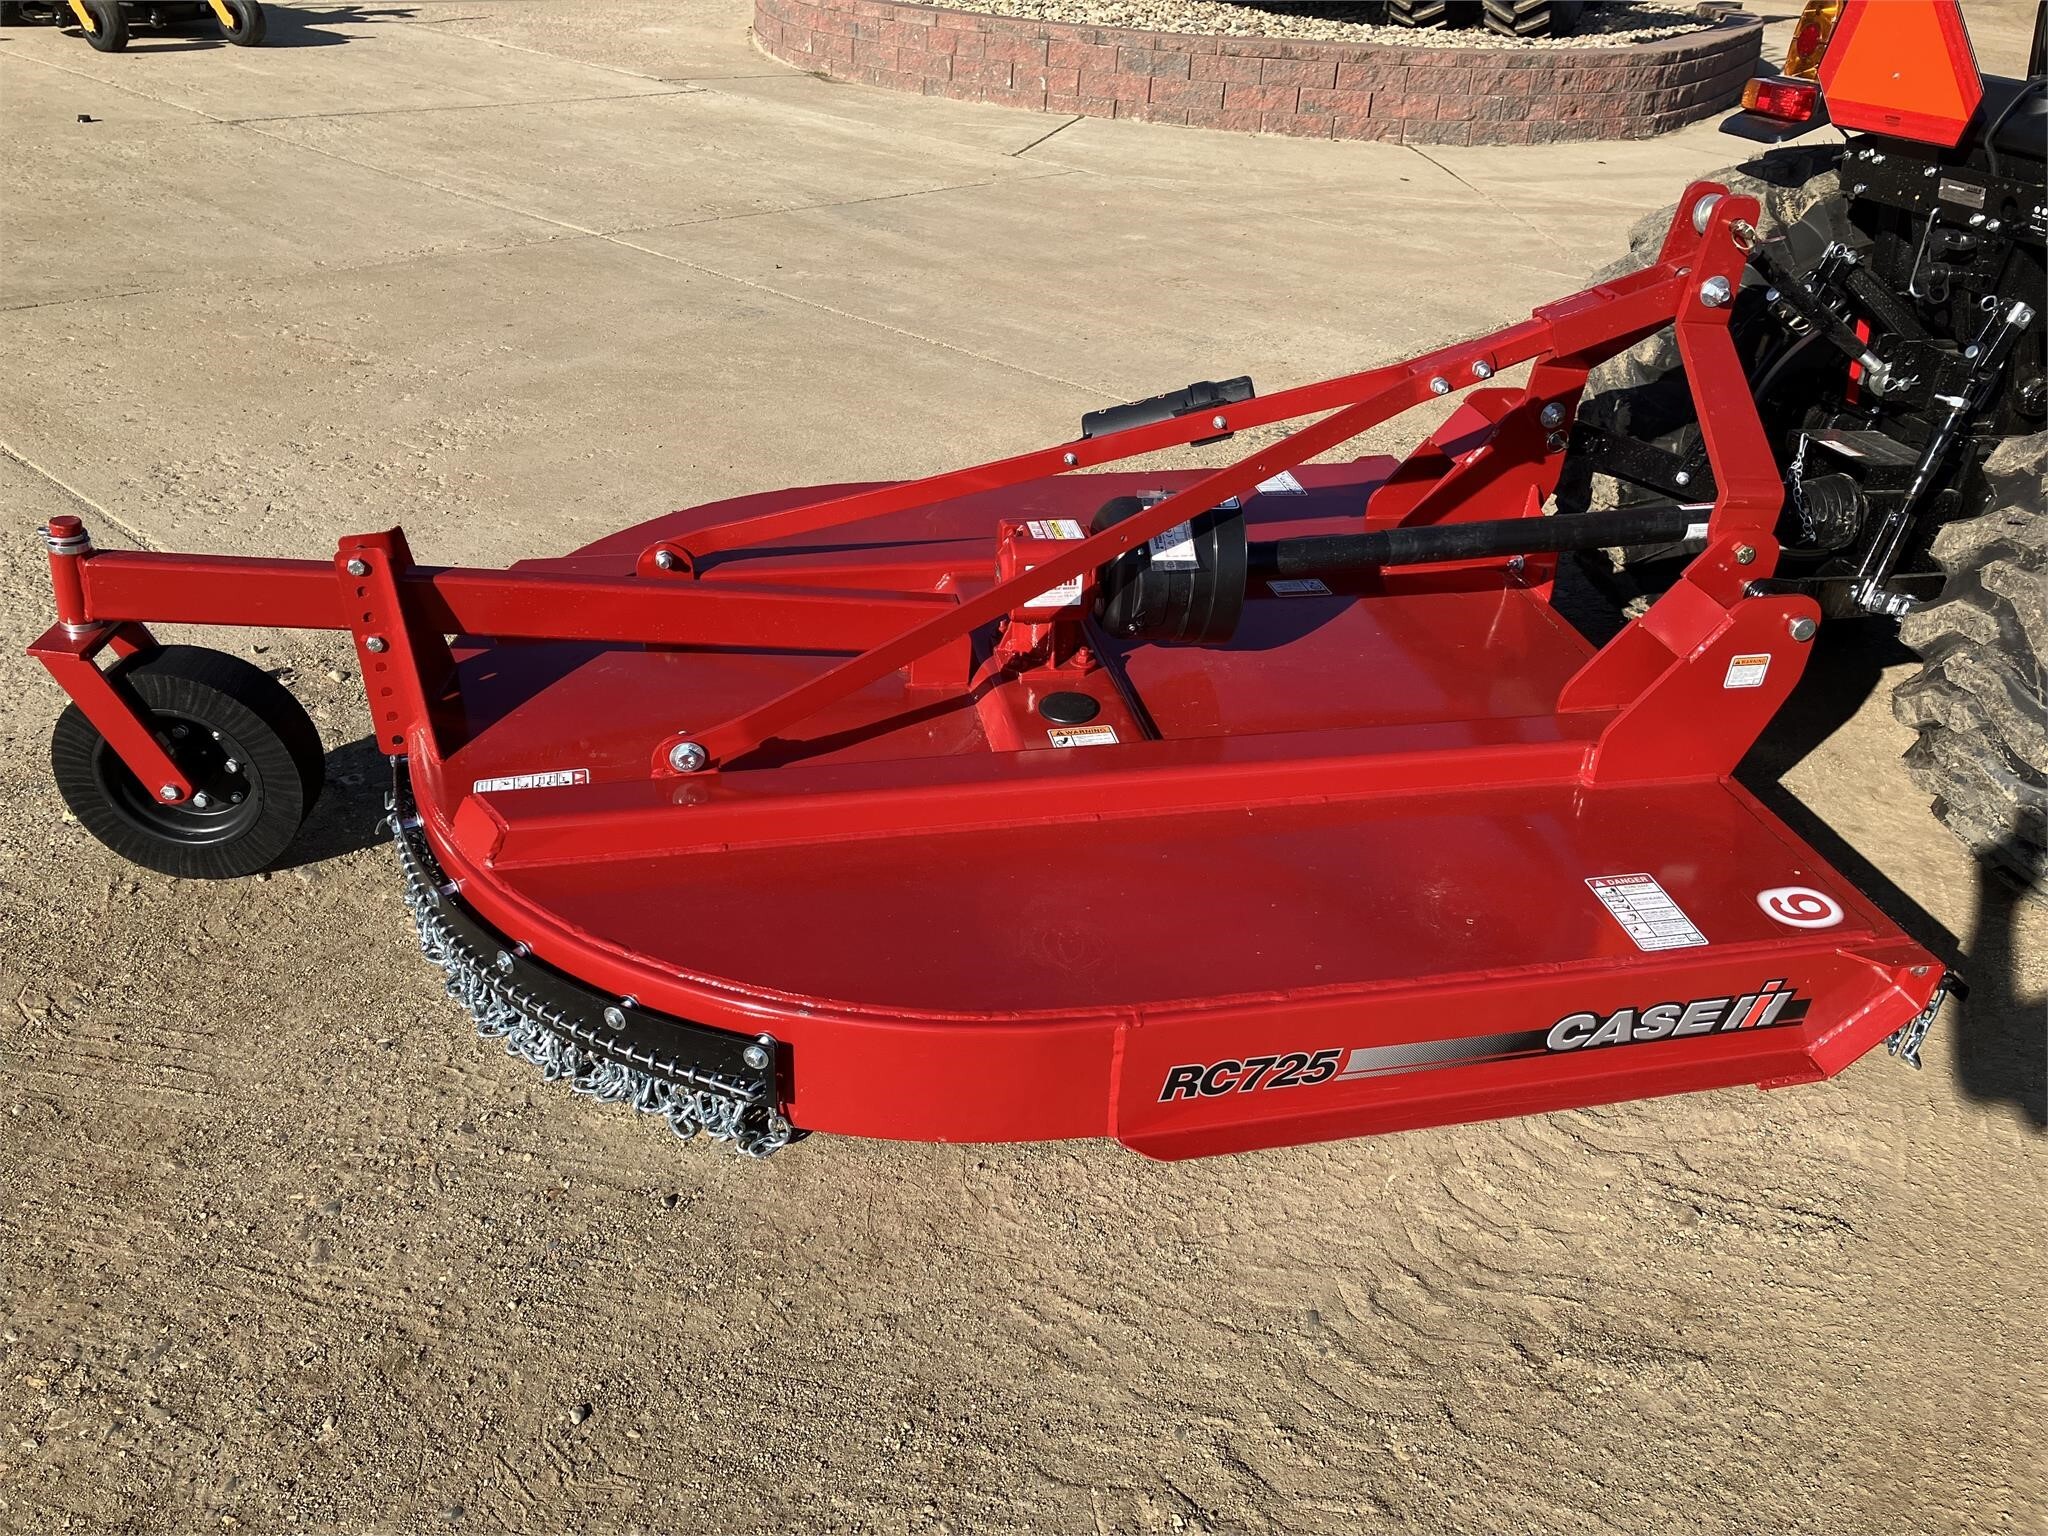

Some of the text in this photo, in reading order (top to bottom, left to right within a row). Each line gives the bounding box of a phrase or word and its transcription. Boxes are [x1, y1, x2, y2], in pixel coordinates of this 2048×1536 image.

[1606, 876, 1649, 886] DANGER
[1546, 998, 1730, 1051] CASE
[1157, 1048, 1344, 1103] RC725
